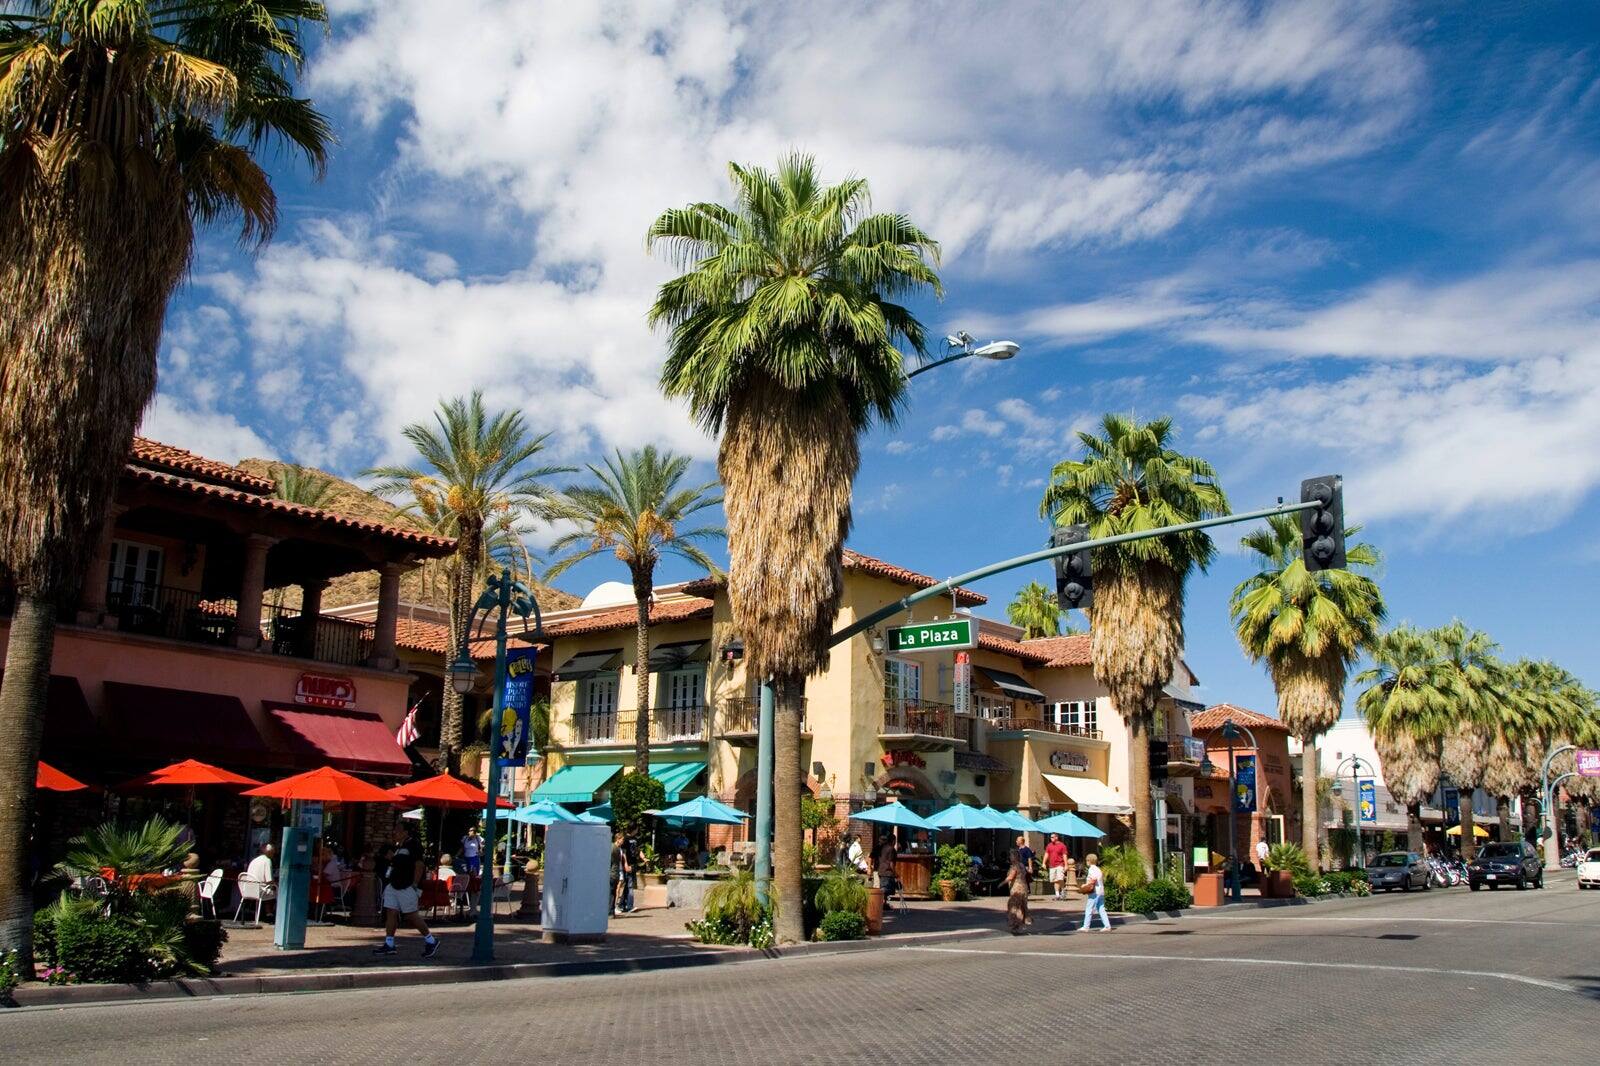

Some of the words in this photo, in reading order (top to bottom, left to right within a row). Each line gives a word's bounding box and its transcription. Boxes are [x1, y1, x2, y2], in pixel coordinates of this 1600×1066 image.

[899, 632, 915, 645] La
[920, 629, 958, 643] Plaza
[308, 696, 343, 706] DINER
